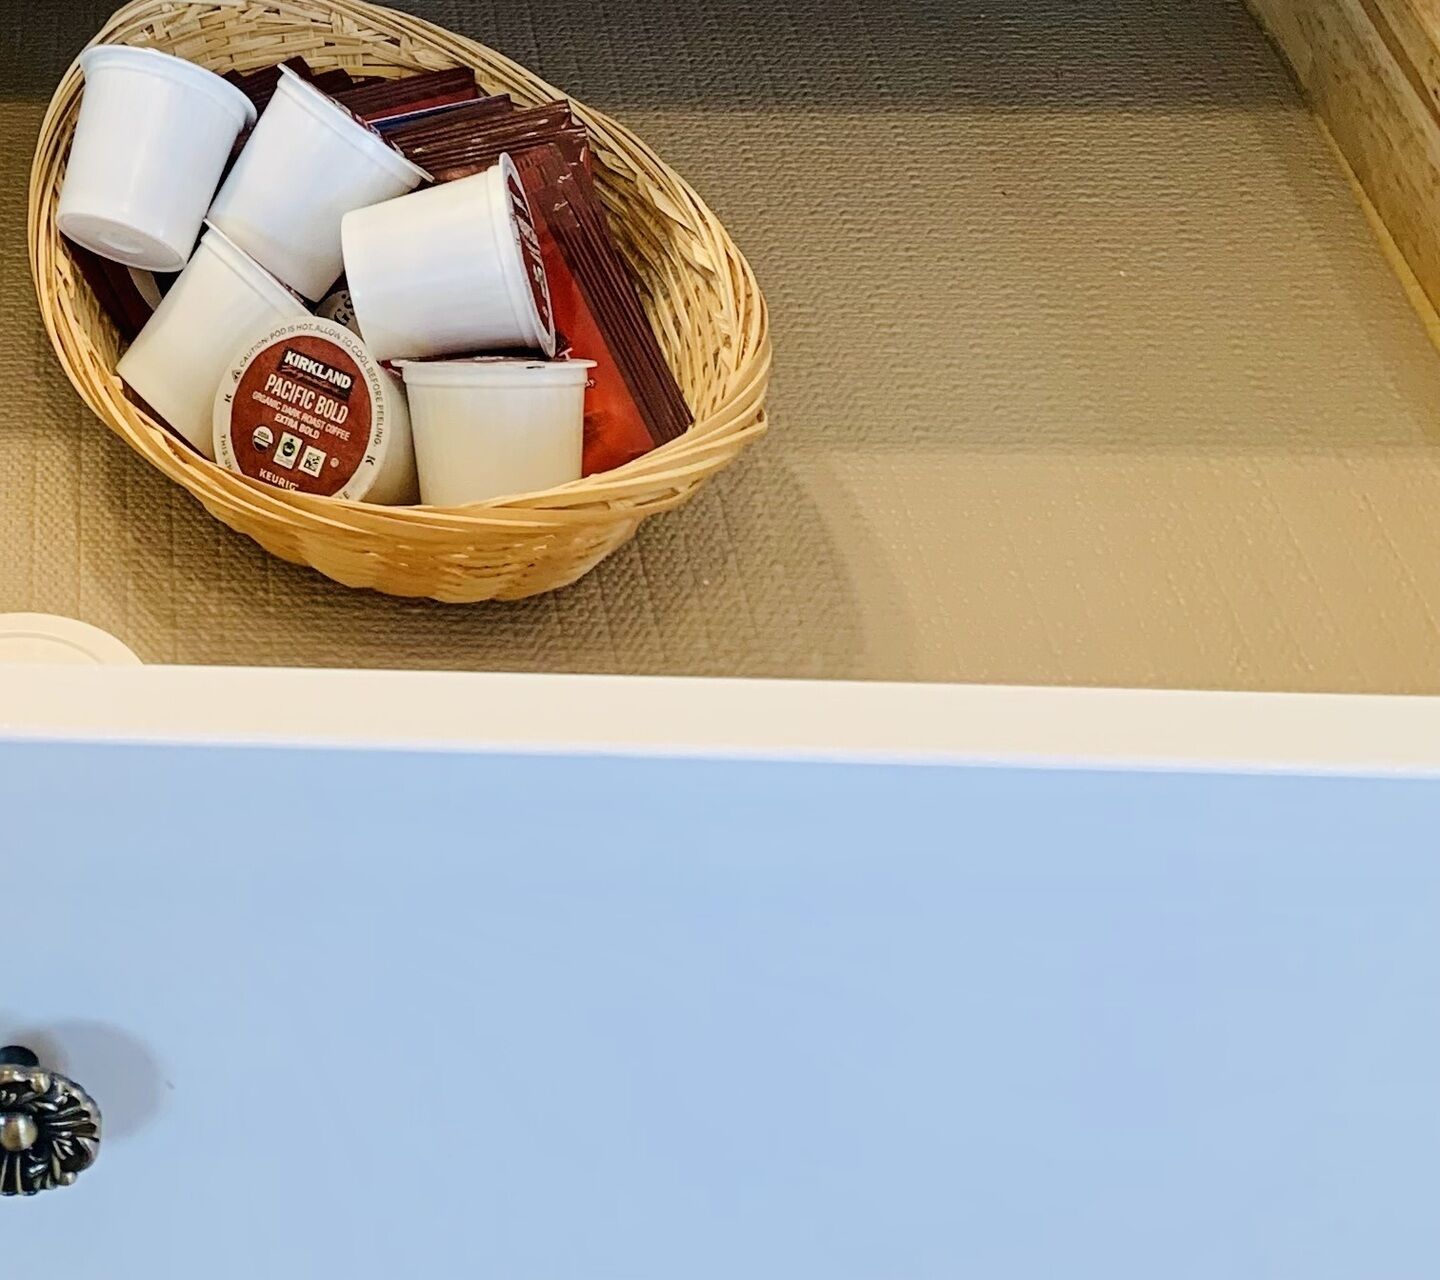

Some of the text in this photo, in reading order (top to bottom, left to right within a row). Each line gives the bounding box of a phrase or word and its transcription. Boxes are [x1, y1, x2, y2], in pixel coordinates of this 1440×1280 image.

[269, 327, 287, 340] POD
[351, 345, 369, 369] COOL
[366, 367, 384, 401] BEFORE
[284, 351, 352, 389] KIRKLAND
[252, 391, 351, 441] ORGANIC DARK ROAST COFFEE
[264, 373, 349, 424] PACIFIC BOLD
[274, 414, 320, 440] EXTRA BOLD
[259, 468, 299, 490] KEURIG
